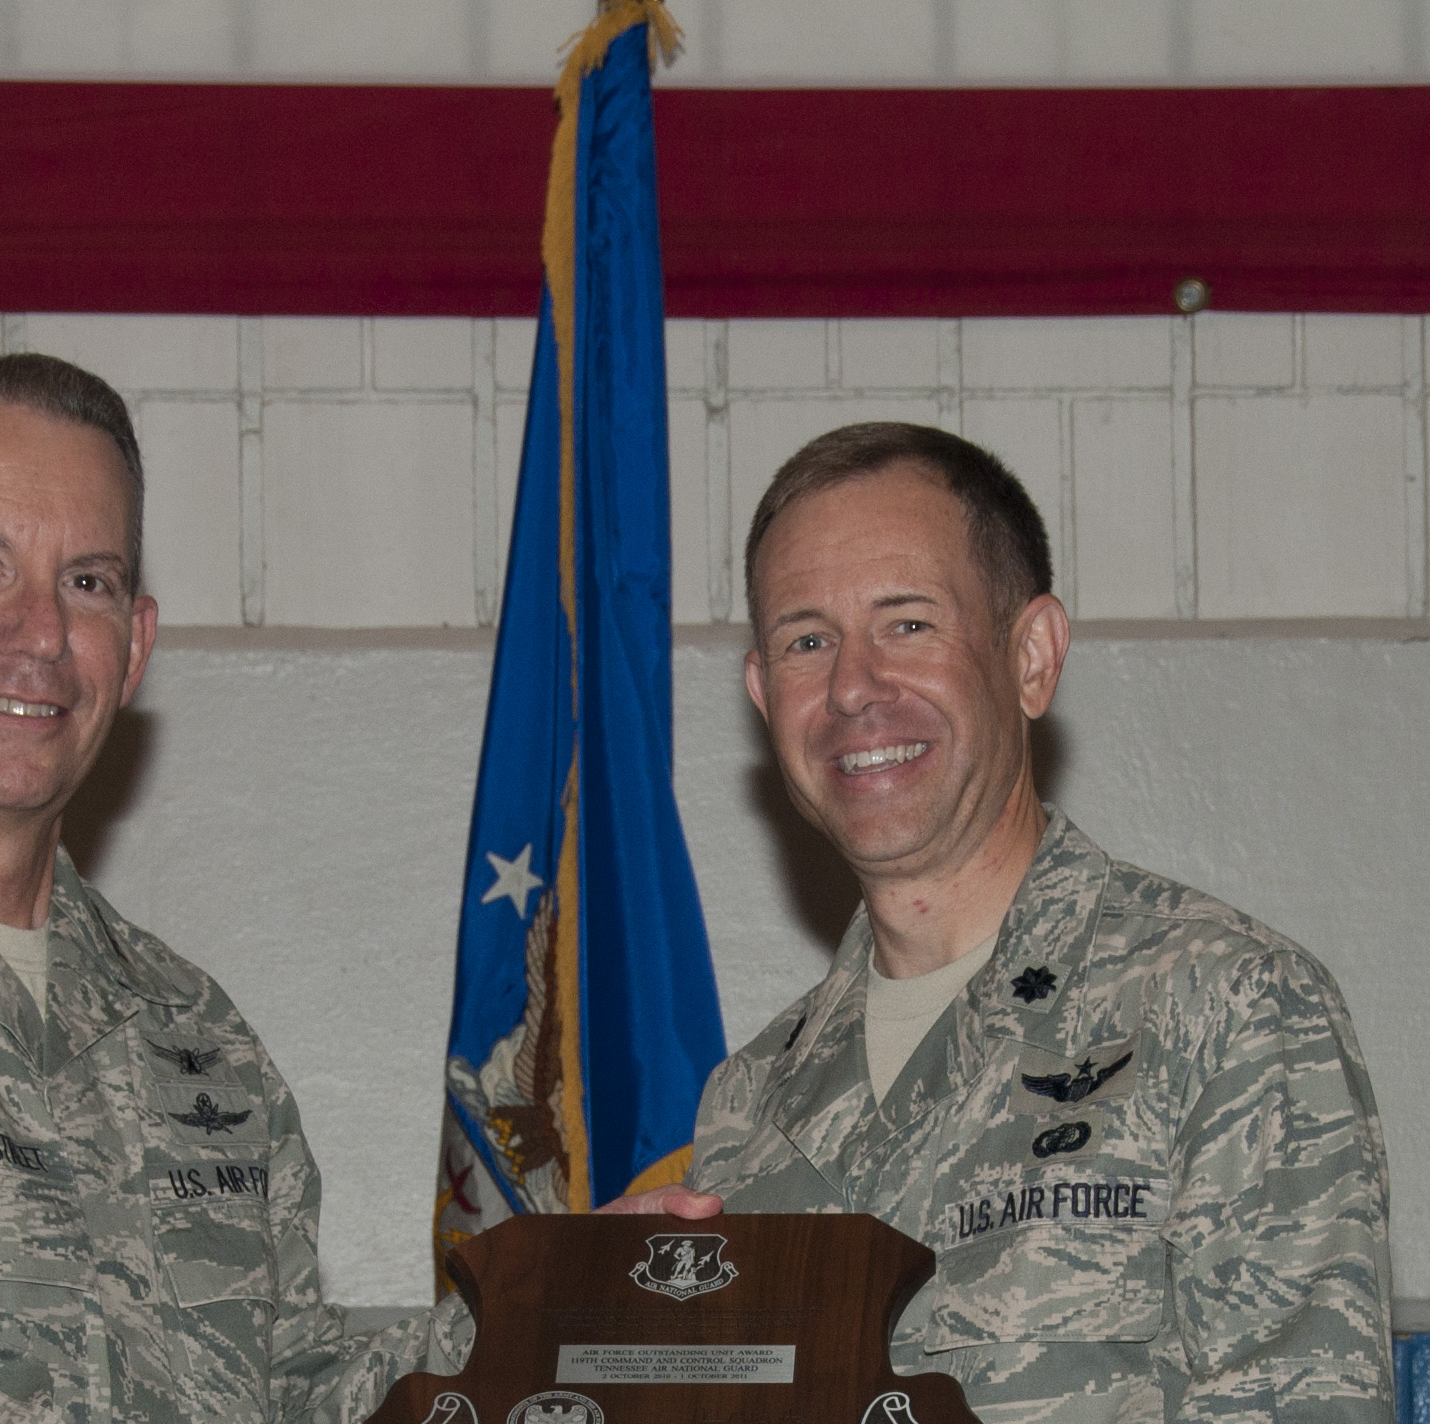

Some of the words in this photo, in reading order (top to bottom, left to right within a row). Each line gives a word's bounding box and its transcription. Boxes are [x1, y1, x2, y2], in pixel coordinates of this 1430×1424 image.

[168, 1168, 214, 1199] U.S.
[215, 1164, 251, 1195] AIR
[958, 1199, 995, 1239] U.S.
[999, 1186, 1045, 1228] AIR
[1052, 1182, 1151, 1219] FORCE
[644, 1281, 658, 1290] AIR
[659, 1284, 698, 1297] NATIONAL
[729, 1357, 783, 1365] SQUADRON
